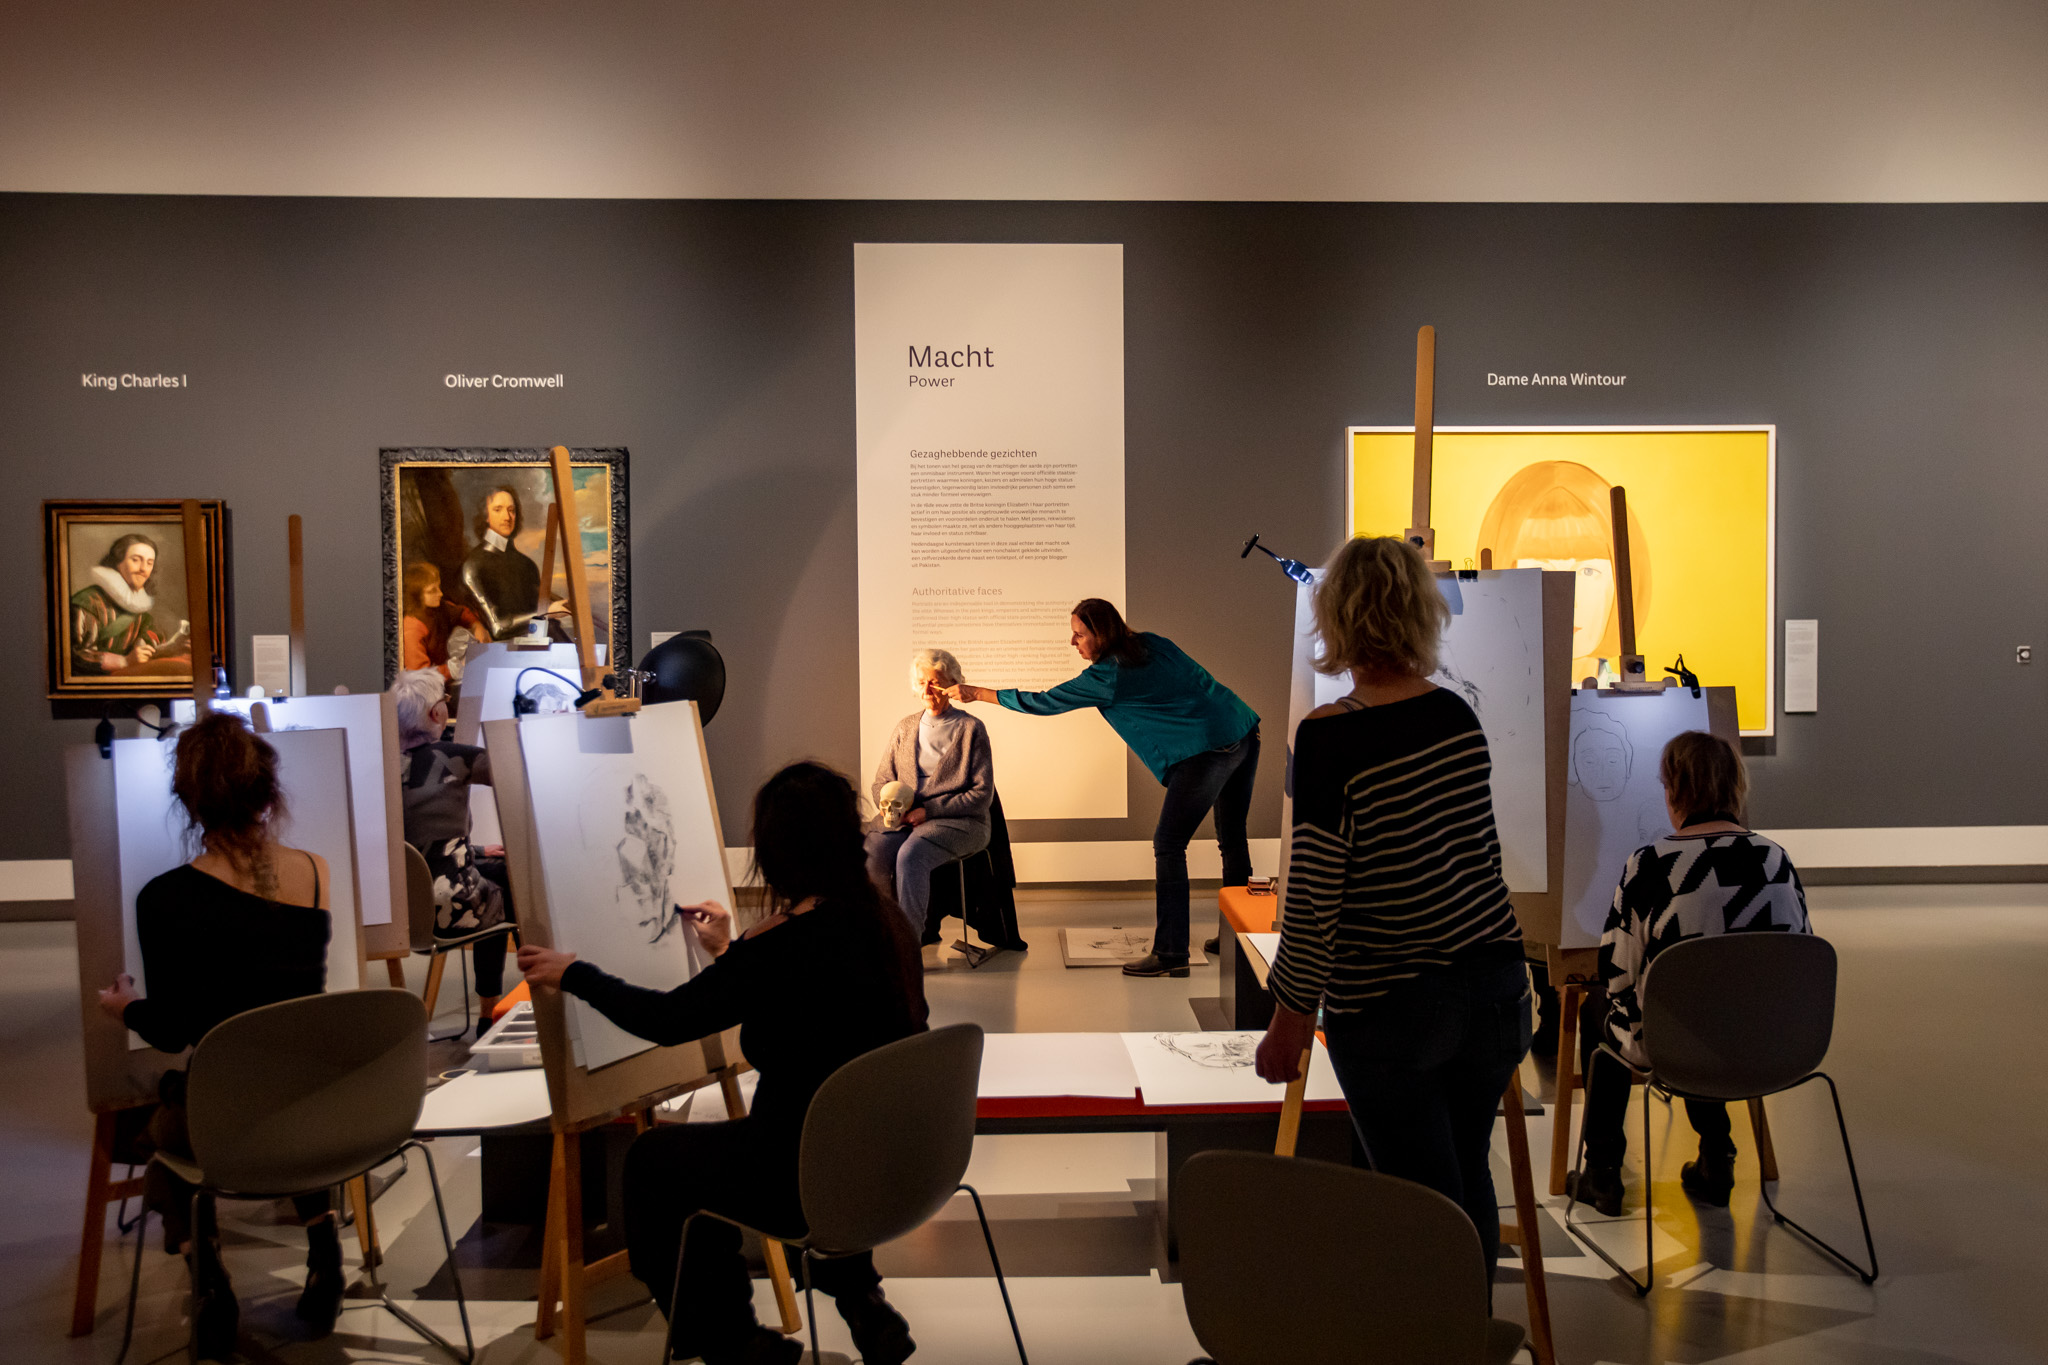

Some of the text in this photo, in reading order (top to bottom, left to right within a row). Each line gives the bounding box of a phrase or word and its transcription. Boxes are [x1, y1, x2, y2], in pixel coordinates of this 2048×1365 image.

[909, 344, 995, 368] Macht
[82, 373, 188, 391] King Charles I
[445, 373, 564, 388] Oliver Cromwell
[909, 375, 955, 388] Power
[1487, 373, 1626, 386] Dame Anna Wintour
[910, 449, 1037, 460] Gezaghebbende gezichten
[912, 586, 1003, 596] Authoritative faces
